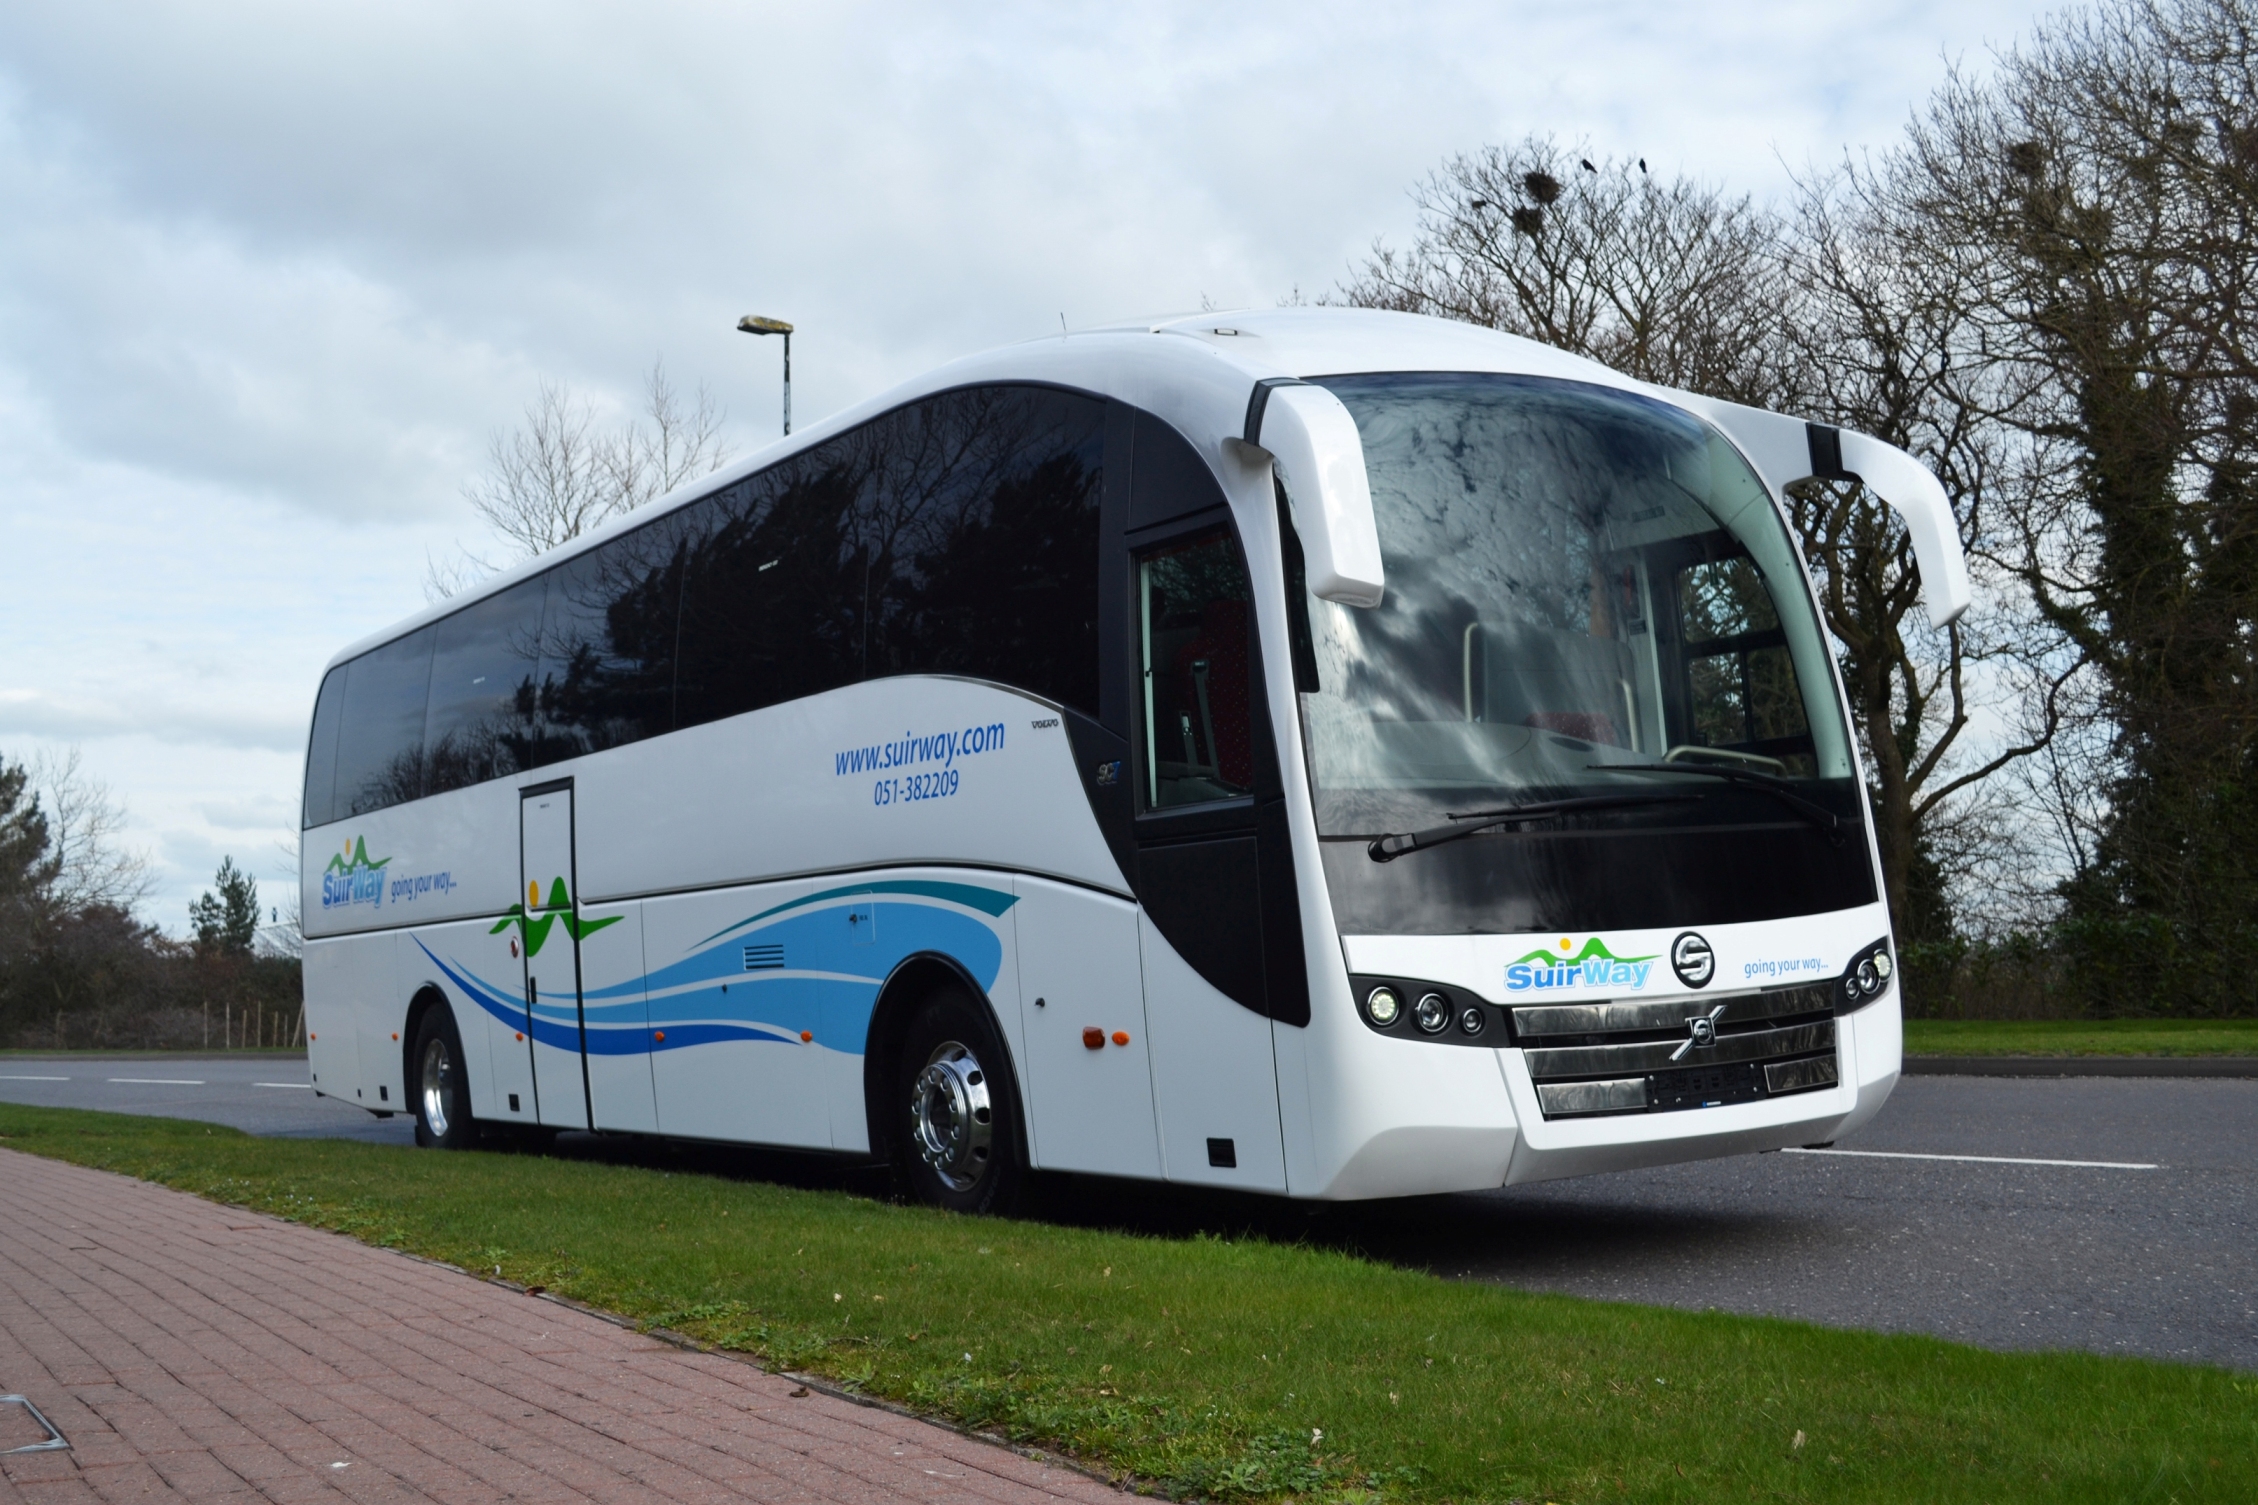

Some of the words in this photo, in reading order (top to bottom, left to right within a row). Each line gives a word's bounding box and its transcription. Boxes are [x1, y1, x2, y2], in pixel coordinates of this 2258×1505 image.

[1031, 718, 1059, 729] VOLVO
[836, 722, 1005, 776] www.suirway.com
[874, 769, 959, 806] 051-382209
[322, 863, 387, 909] SuirWay
[391, 874, 413, 903] going
[414, 874, 433, 899] your
[1504, 958, 1653, 992] SuirWay
[1744, 958, 1776, 979] going
[1777, 959, 1800, 976] your
